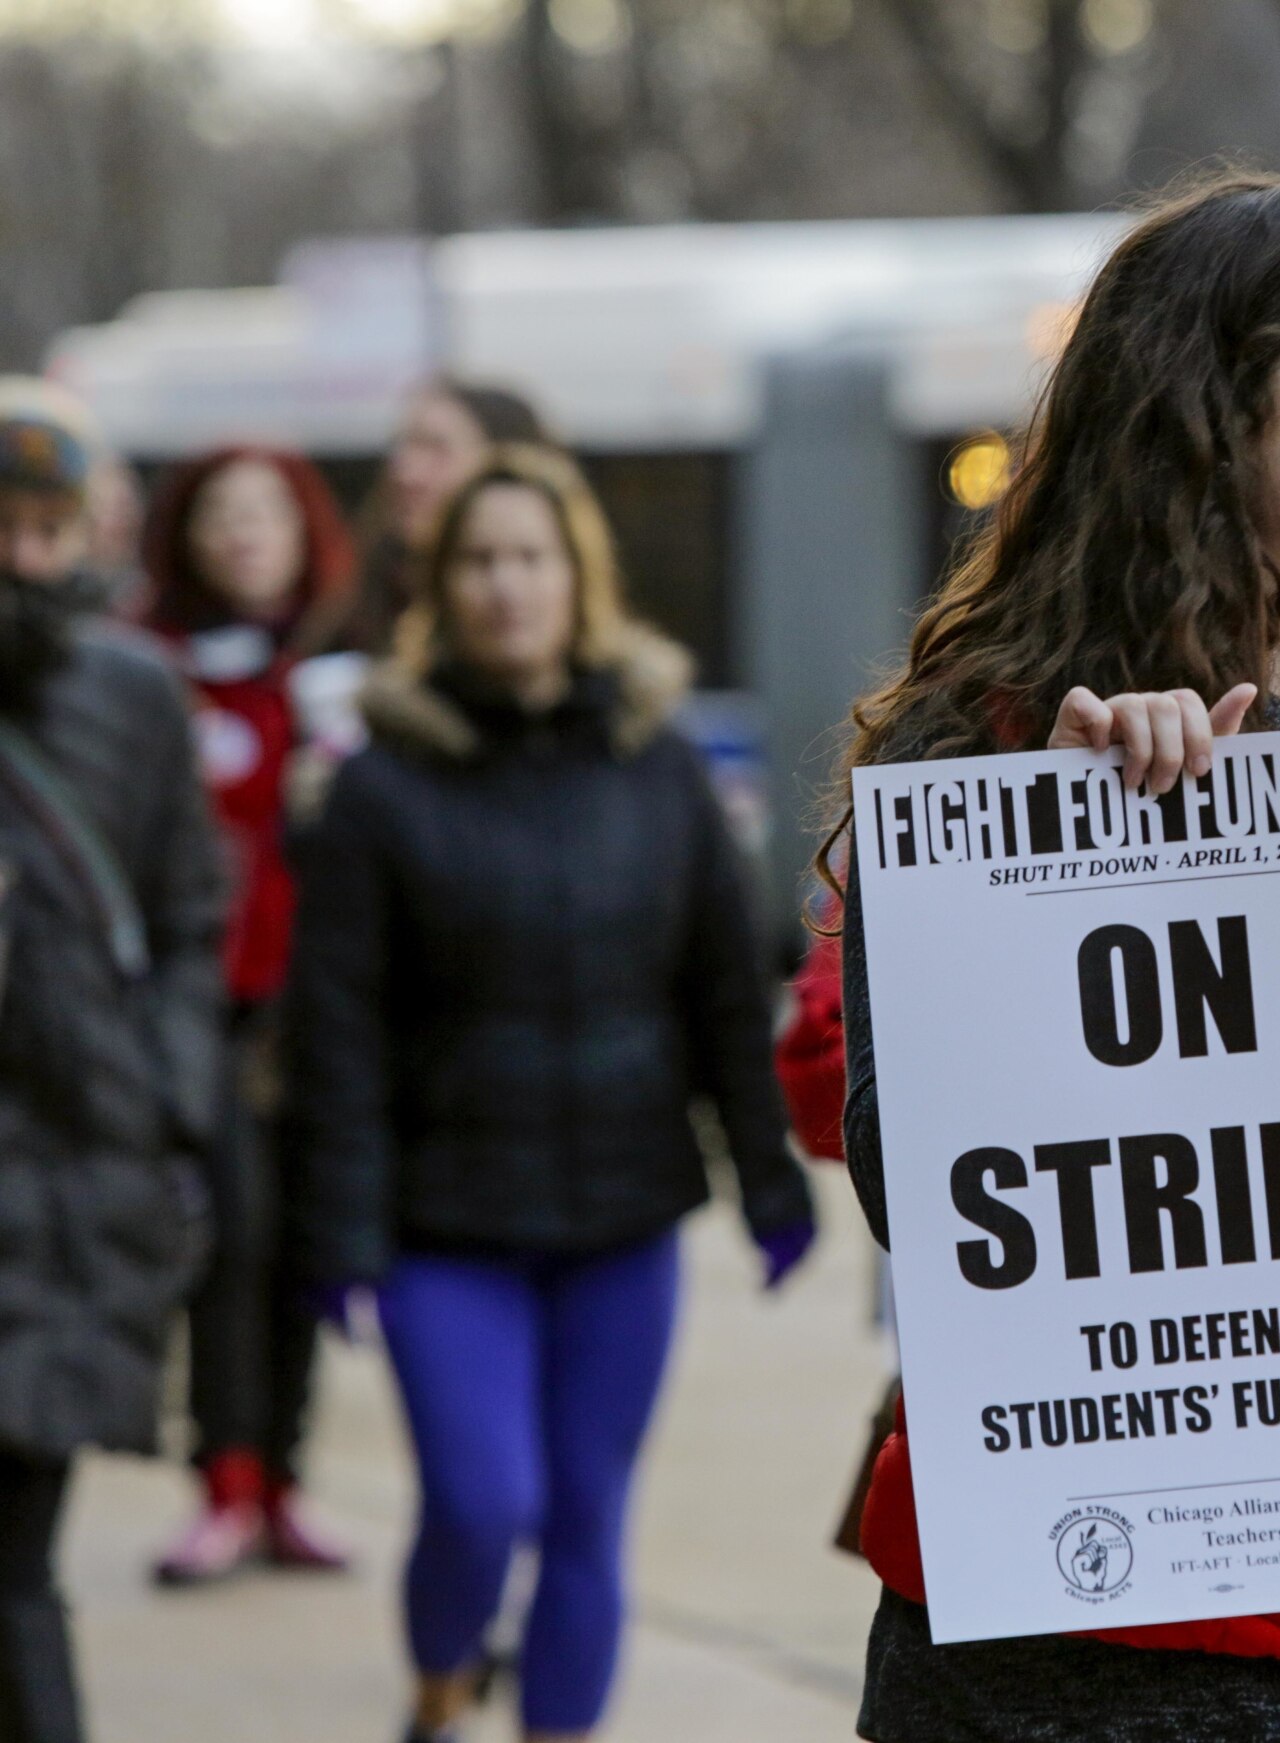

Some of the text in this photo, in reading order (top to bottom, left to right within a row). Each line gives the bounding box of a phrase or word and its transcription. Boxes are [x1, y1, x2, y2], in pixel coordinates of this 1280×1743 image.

[874, 772, 1040, 868] FIGHT
[1057, 764, 1166, 852] FOR
[989, 864, 1053, 887] SHUT
[1059, 861, 1083, 880] IT
[1089, 854, 1159, 877] DOWN
[1177, 847, 1247, 869] APRIL
[1252, 845, 1269, 864] 1,
[1077, 914, 1258, 1067] ON
[1080, 1321, 1138, 1372] TO
[1048, 1505, 1136, 1541] UNION STRONG
[1147, 1504, 1224, 1524] Chicago
[1170, 1556, 1232, 1574] IFT-AFT
[1064, 1586, 1105, 1605] Chicago
